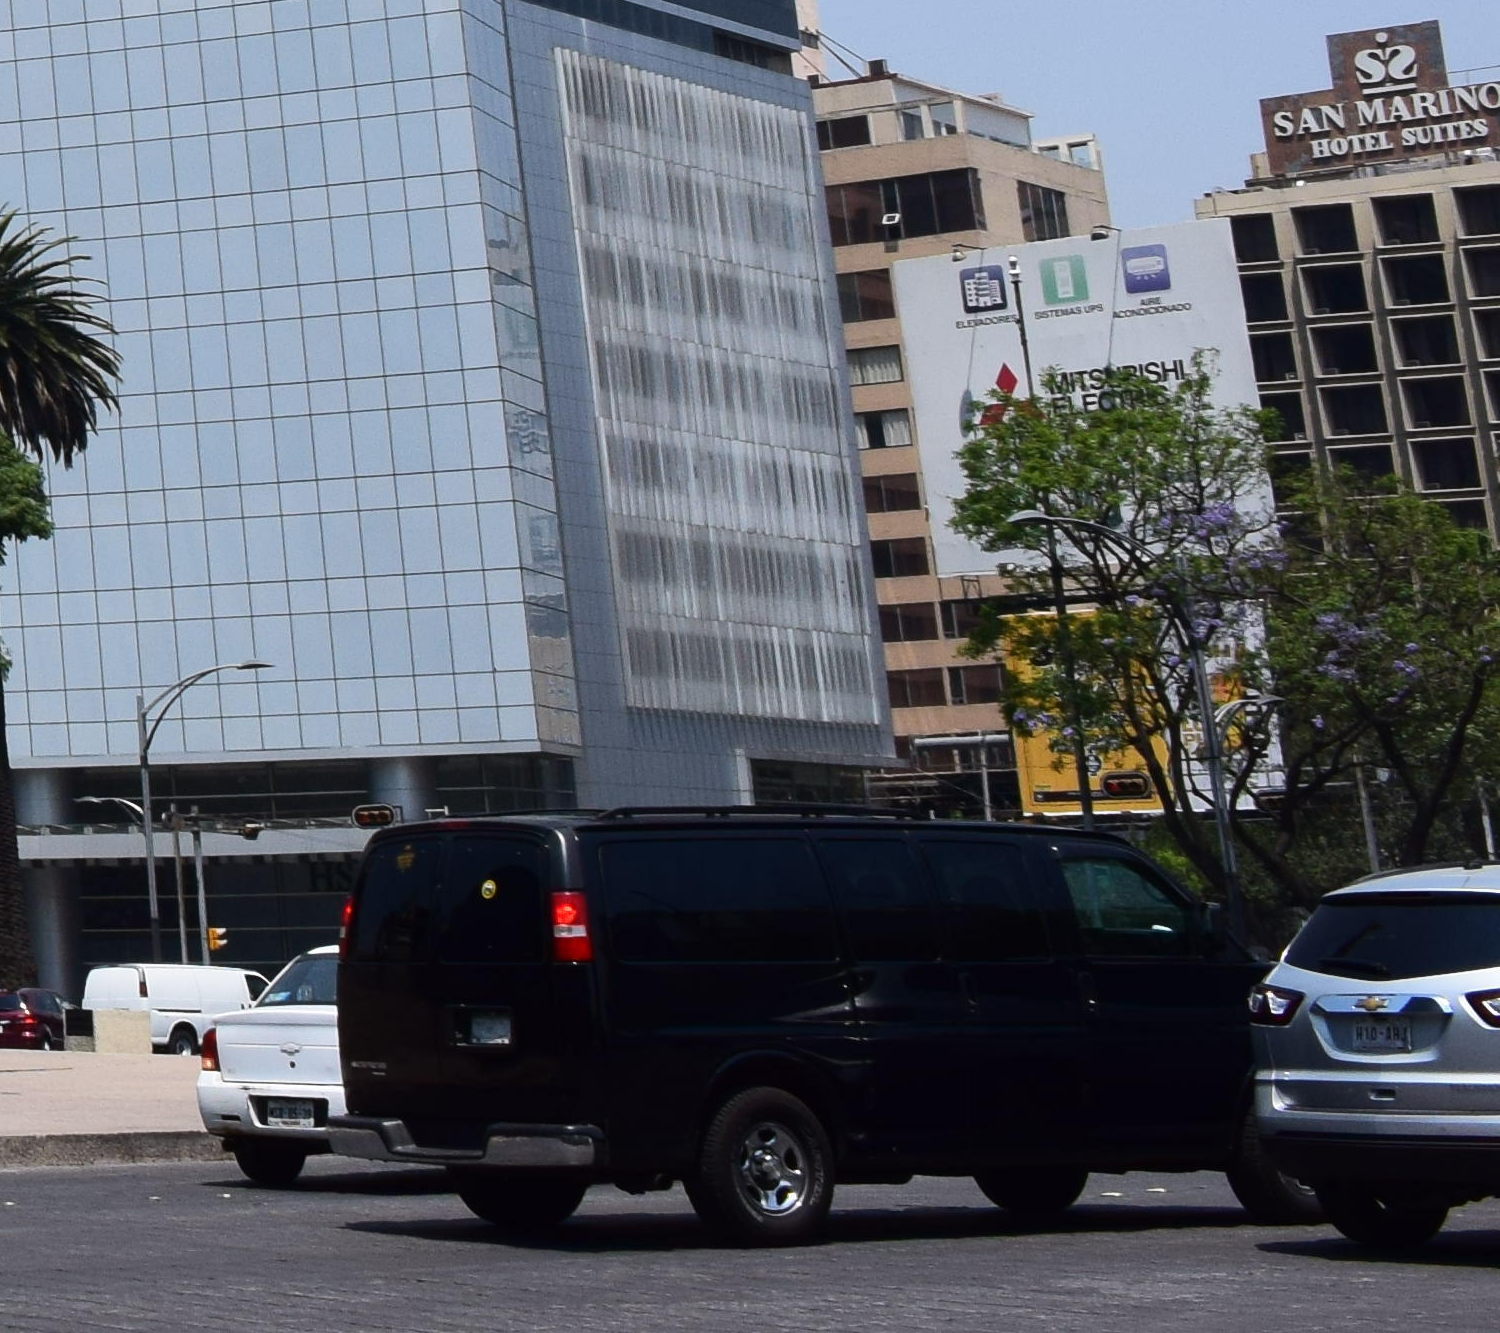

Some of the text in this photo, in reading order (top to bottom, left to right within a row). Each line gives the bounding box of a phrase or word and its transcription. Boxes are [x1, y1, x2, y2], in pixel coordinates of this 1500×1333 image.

[1273, 82, 1500, 138] SAN MARINO
[1310, 118, 1489, 159] HOTEL SUITES
[1140, 296, 1162, 307] AIRE
[1034, 303, 1104, 320] SISTEMAS UPS
[1112, 302, 1192, 319] ACONDICIONADO
[956, 313, 1019, 329] ELEVADORES
[1049, 359, 1185, 395] MITSBISHI
